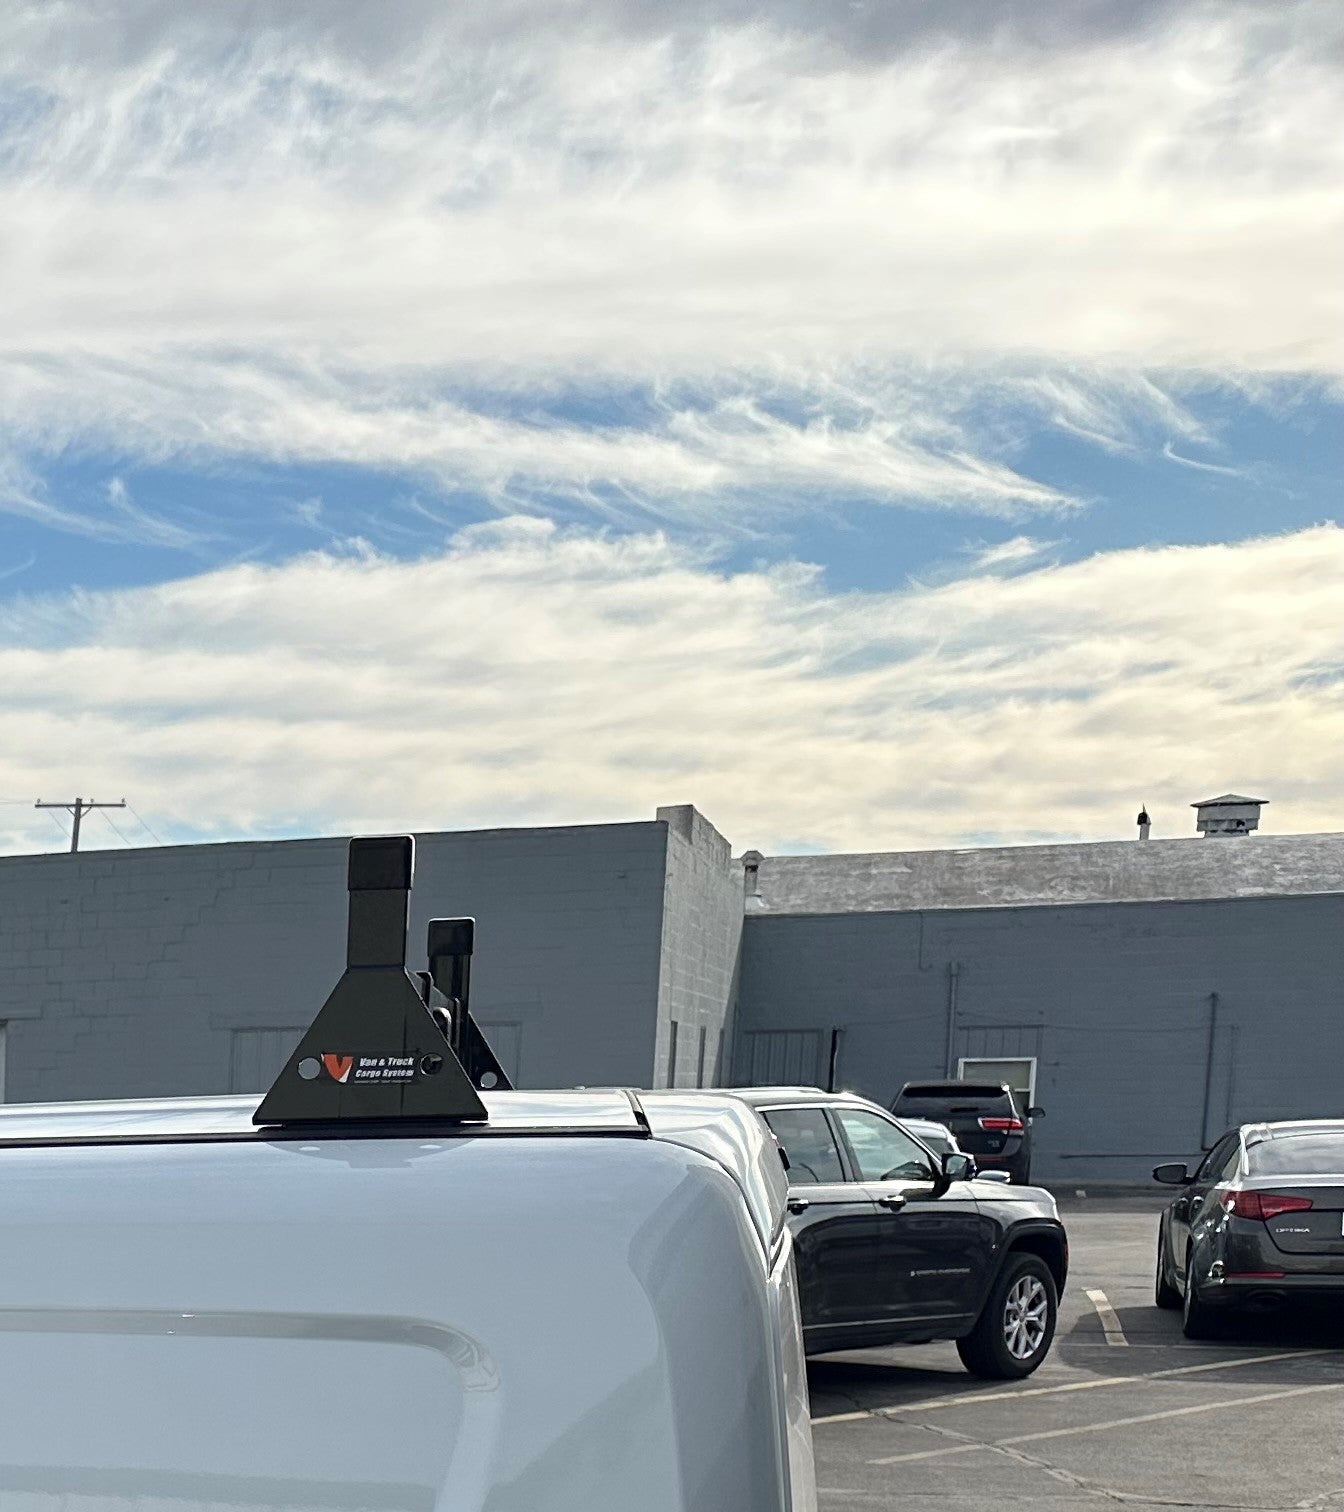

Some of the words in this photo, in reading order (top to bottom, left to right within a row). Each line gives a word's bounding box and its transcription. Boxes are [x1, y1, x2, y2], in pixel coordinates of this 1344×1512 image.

[359, 1057, 377, 1067] Van
[378, 1058, 385, 1066] &
[387, 1056, 414, 1066] Truck
[355, 1069, 381, 1078] Cargo
[382, 1069, 414, 1078] System
